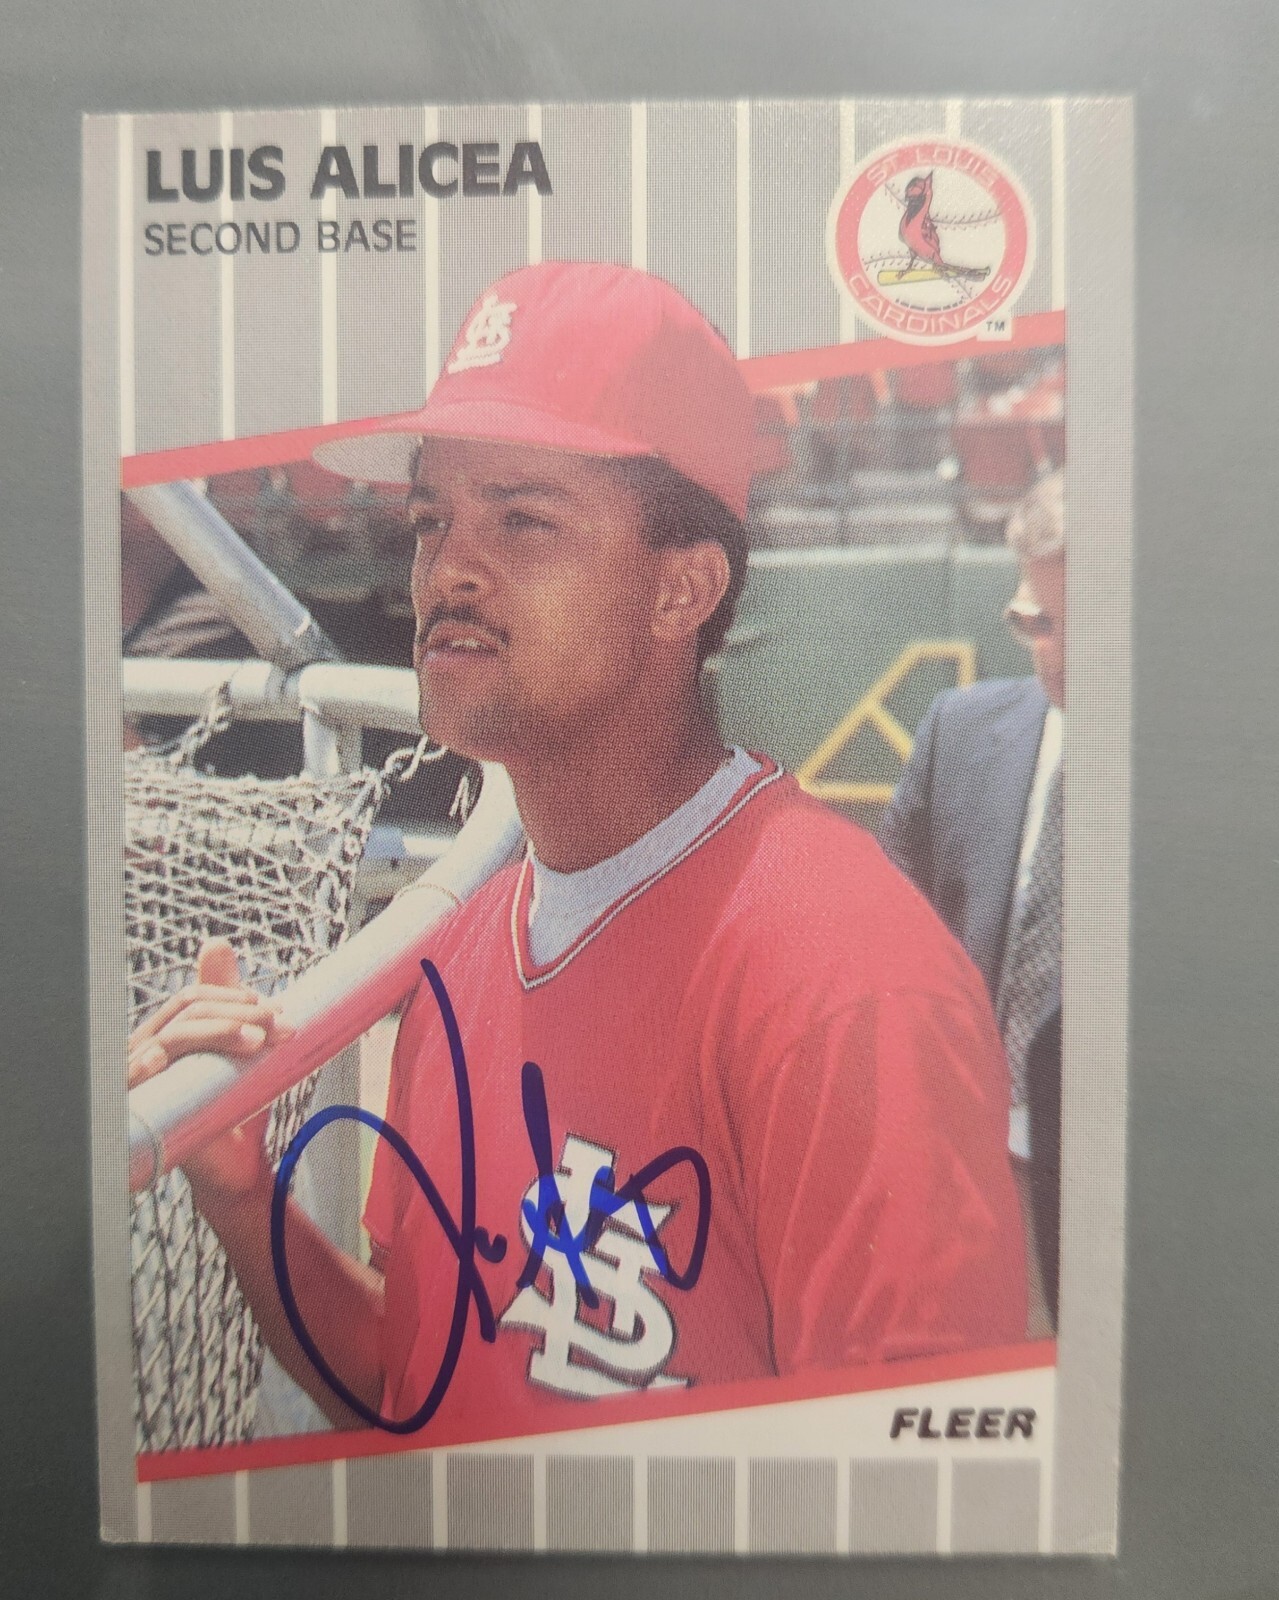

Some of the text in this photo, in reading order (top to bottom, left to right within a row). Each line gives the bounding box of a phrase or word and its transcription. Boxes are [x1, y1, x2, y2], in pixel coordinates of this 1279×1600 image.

[146, 142, 553, 203] LUIS ALICEA
[915, 146, 1001, 189] LOUIS
[144, 219, 417, 256] SECOND BASE
[849, 274, 1012, 335] CARDINALS
[985, 321, 1006, 332] TM
[889, 1406, 1037, 1439] FLEER
